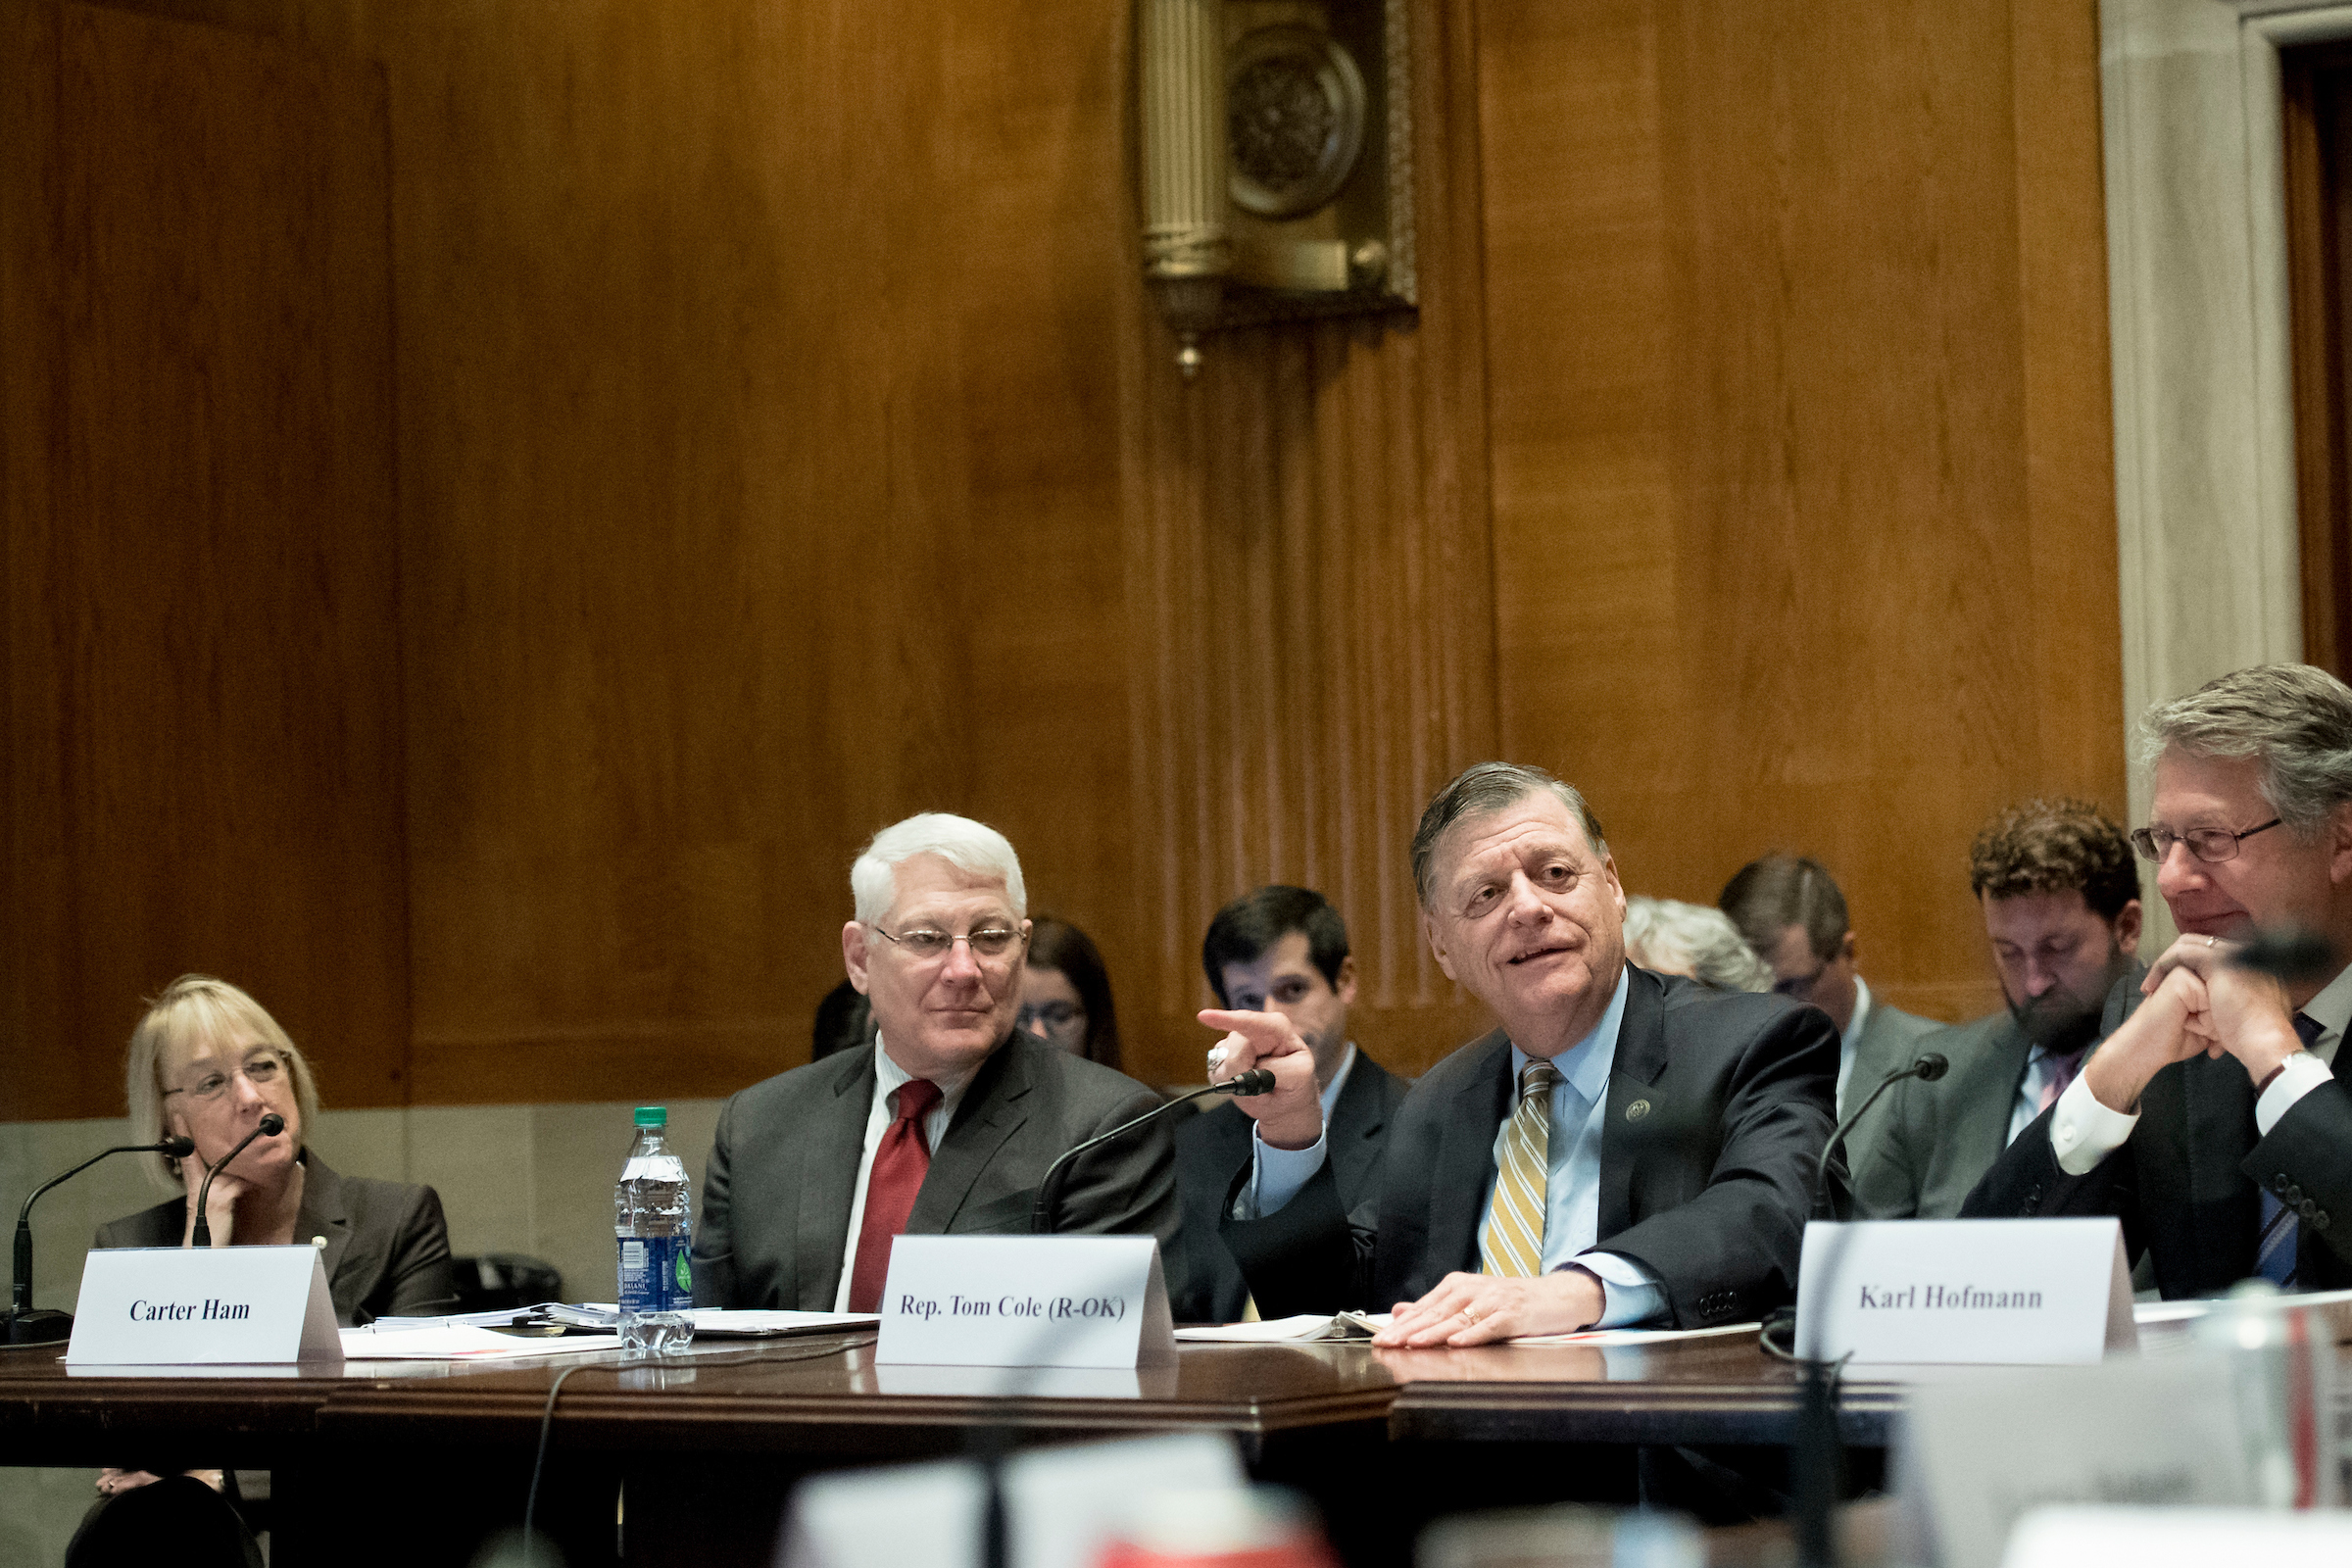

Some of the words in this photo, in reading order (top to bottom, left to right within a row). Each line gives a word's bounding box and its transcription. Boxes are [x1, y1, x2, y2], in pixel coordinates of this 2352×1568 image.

[1859, 1285, 1916, 1309] Karl
[1924, 1285, 2043, 1309] Hofmann
[129, 1298, 197, 1322] Carter
[200, 1298, 251, 1321] Ham
[900, 1295, 943, 1322] Rep.
[950, 1295, 992, 1317] Tom
[998, 1296, 1043, 1318] Cole
[1048, 1296, 1126, 1324] (R-OK)
